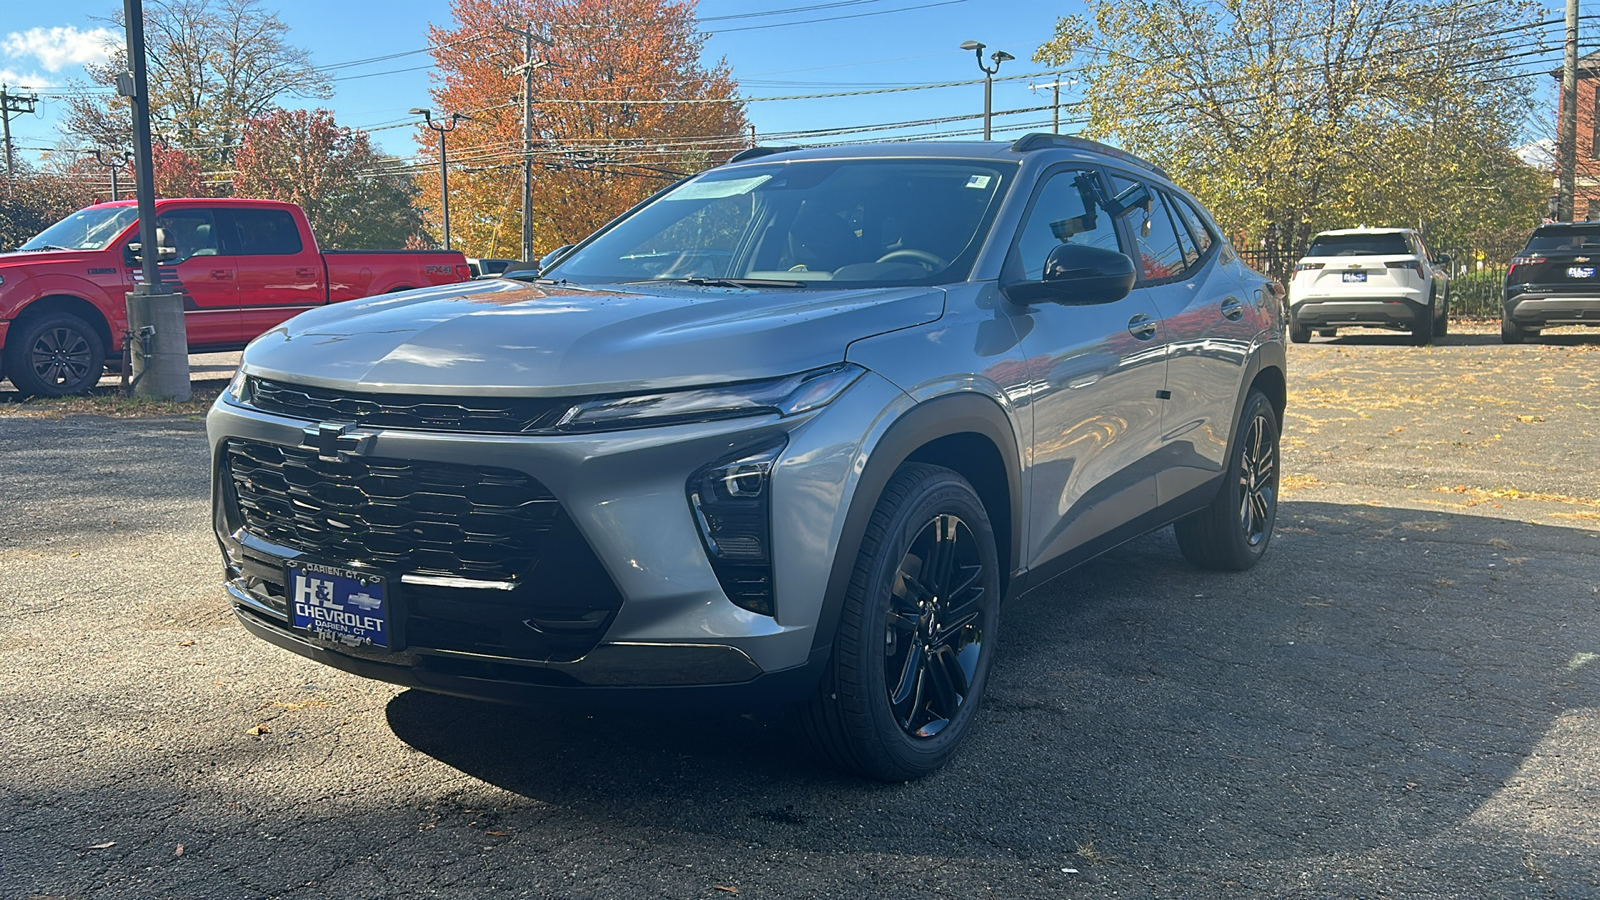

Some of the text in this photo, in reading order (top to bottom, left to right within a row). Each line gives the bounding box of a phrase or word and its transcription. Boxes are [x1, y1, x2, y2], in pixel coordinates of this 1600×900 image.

[425, 264, 452, 275] FX4
[295, 575, 344, 611] H&L
[295, 603, 384, 632] CHEVROLET
[353, 627, 366, 636] CT
